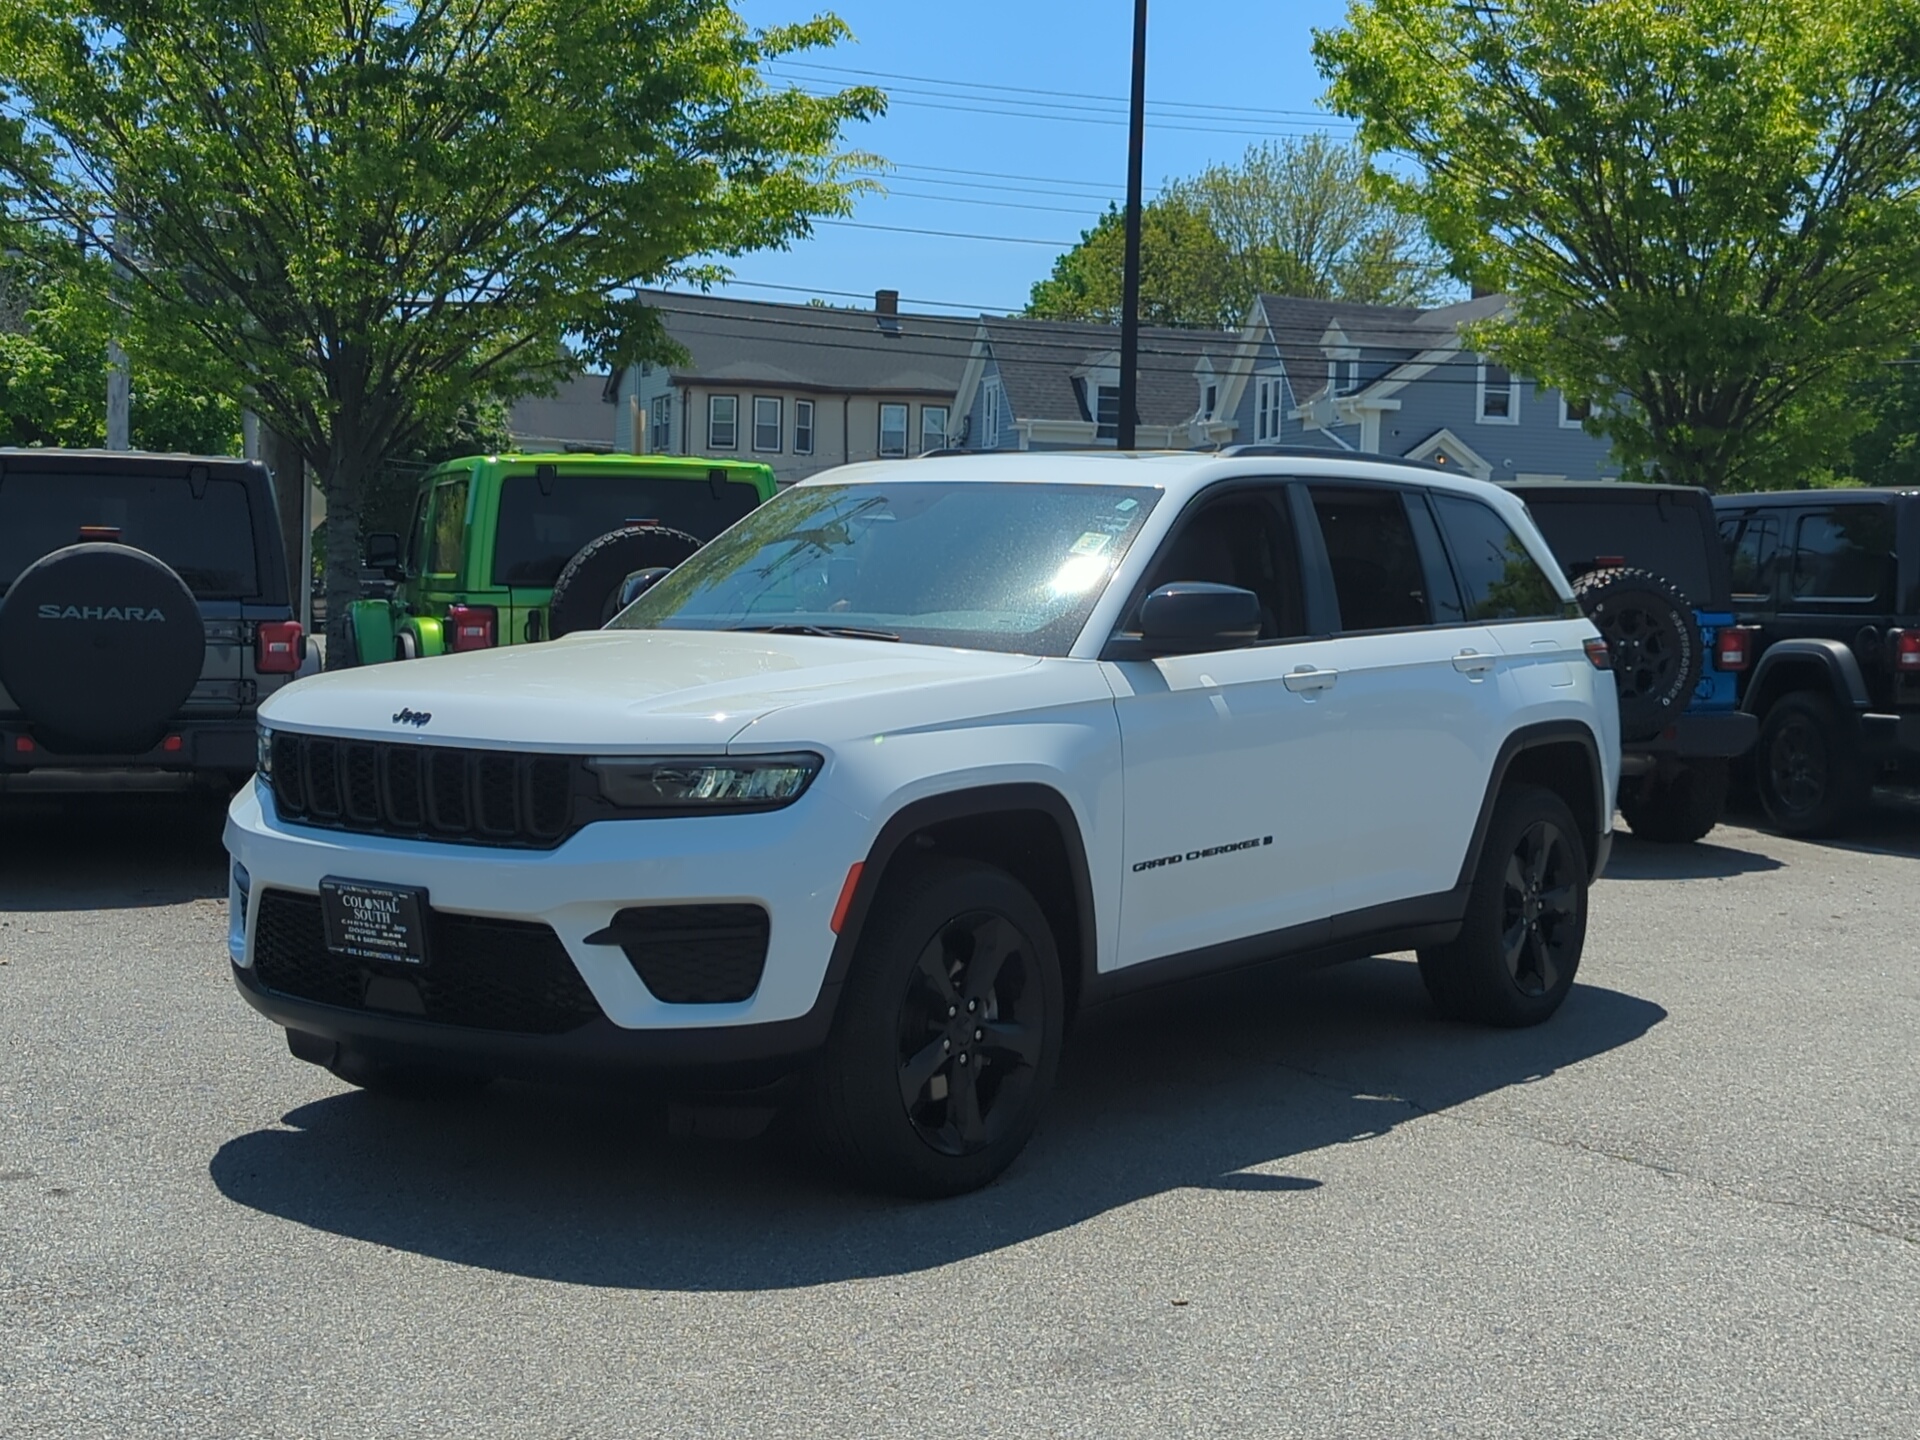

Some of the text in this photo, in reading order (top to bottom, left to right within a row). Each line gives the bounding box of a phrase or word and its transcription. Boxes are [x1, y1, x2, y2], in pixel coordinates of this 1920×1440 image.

[38, 605, 166, 622] SAHARA
[393, 708, 432, 728] Jeep
[1132, 838, 1260, 872] GRAND CHEROKEE
[342, 895, 399, 913] COLONIAL
[341, 918, 387, 930] CHRYSLER
[353, 908, 391, 924] SOUTH
[348, 926, 377, 936] DODGE
